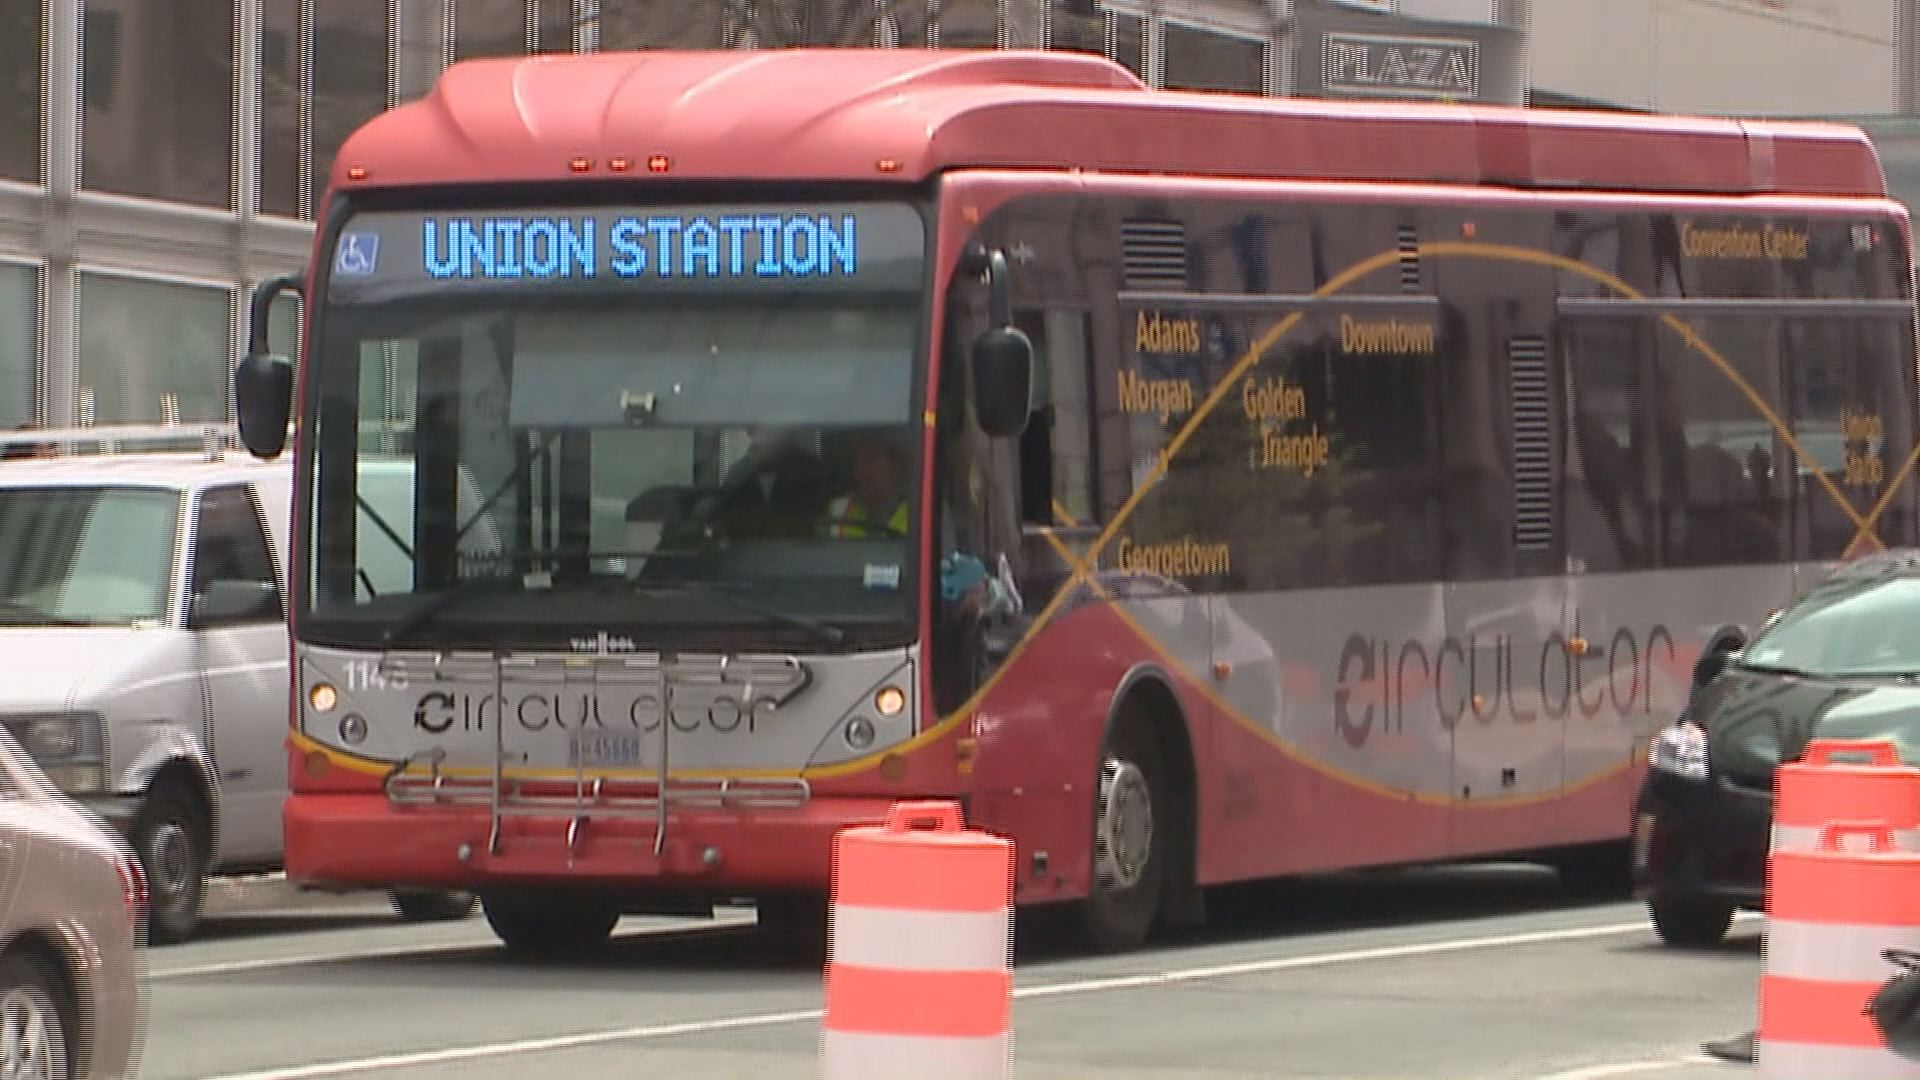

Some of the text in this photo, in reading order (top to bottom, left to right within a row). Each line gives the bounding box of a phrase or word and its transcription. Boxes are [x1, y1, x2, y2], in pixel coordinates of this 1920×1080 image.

[1331, 43, 1473, 88] PLAZA
[422, 214, 857, 278] UNION STATION
[1135, 310, 1200, 352] Adams
[1341, 313, 1434, 354] Downtown
[1117, 369, 1193, 426] Morgan
[1242, 376, 1306, 421] Golden
[1260, 422, 1330, 479] Triangle
[1118, 537, 1232, 578] Georgetown
